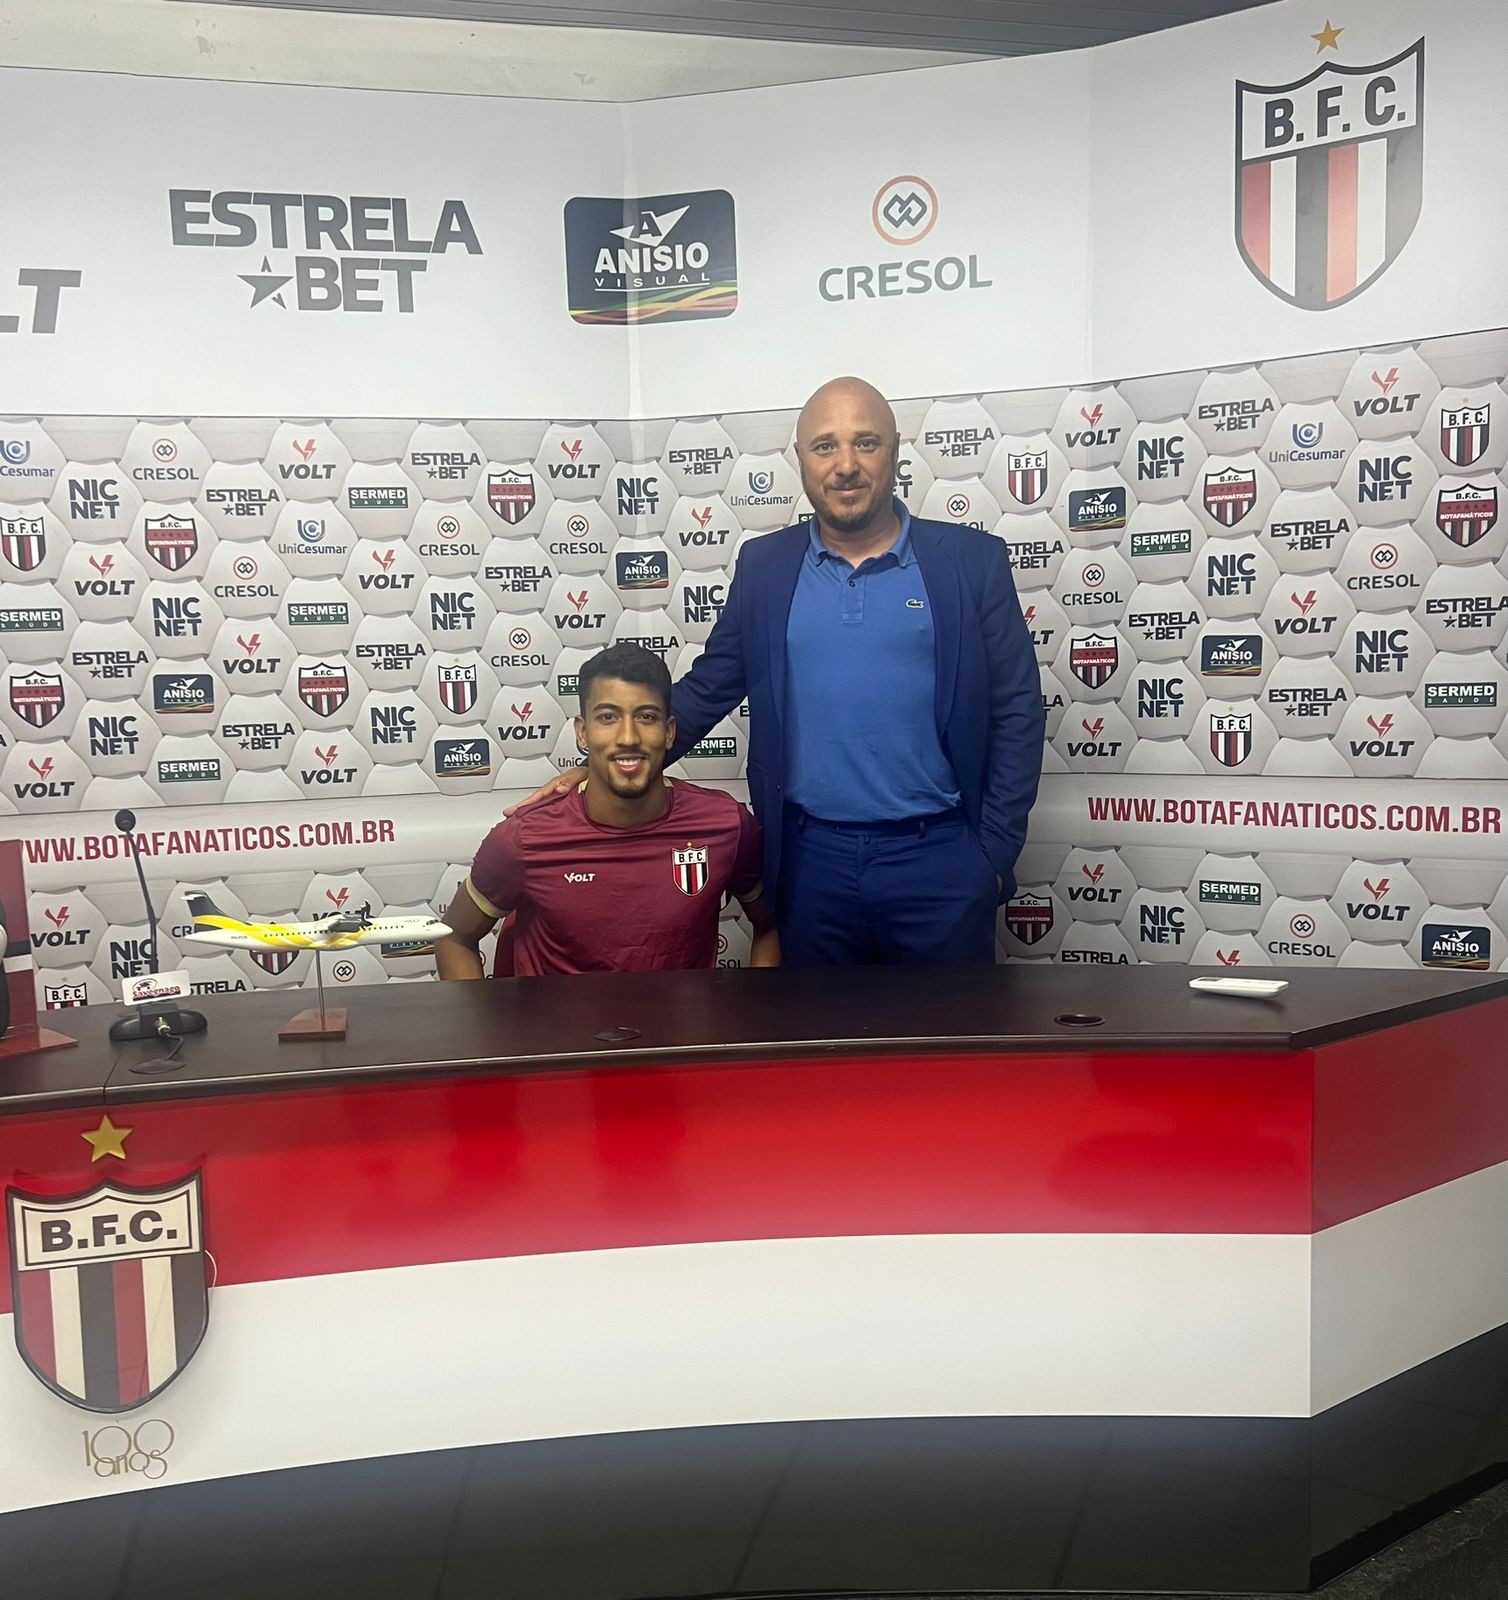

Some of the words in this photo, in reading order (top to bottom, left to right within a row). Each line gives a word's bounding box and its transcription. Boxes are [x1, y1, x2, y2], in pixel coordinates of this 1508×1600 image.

[1265, 76, 1406, 149] B.F.C.
[169, 189, 483, 255] ESTRELA
[595, 242, 709, 273] ANISIO
[295, 255, 427, 313] BET
[595, 272, 710, 287] VISUAL
[818, 254, 993, 302] CRESOL
[1199, 397, 1275, 419] ESTRELA
[1353, 393, 1421, 417] VOLT
[1227, 414, 1260, 432] BET
[925, 427, 995, 445] ESTRELA
[1065, 428, 1121, 448] VOLT
[669, 447, 733, 463] ESTRELA
[952, 442, 981, 457] BET
[1138, 436, 1184, 462] NIC
[1269, 449, 1345, 463] UniCesumar
[411, 452, 480, 466] ESTRELA
[0, 465, 55, 477] Cesumar
[133, 467, 199, 480] CRESOL
[279, 464, 336, 479] VOLT
[439, 466, 469, 479] BET
[548, 464, 600, 479] VOLT
[693, 462, 722, 476] BET
[1138, 458, 1185, 480] NET
[1359, 455, 1412, 482] NIC
[69, 479, 118, 500] NIC
[206, 489, 280, 502] ESTRELA
[350, 489, 406, 499] SERMED
[617, 477, 658, 498] NIC
[1359, 479, 1412, 503] NET
[618, 498, 659, 515] NET
[730, 494, 793, 507] UniCesumar
[71, 501, 120, 519] NET
[234, 503, 267, 516] BET
[1078, 502, 1117, 516] ANISIO
[1271, 518, 1350, 538] ESTRELA
[679, 530, 729, 546] VOLT
[1133, 532, 1189, 547] SERMED
[1300, 536, 1335, 551] BET
[278, 543, 347, 554] UniCesumar
[419, 544, 480, 556] CRESOL
[549, 542, 608, 554] CRESOL
[1006, 541, 1064, 555] TRELA
[1020, 555, 1051, 569] BET
[1208, 553, 1256, 577] NIC
[485, 565, 552, 579] ESTRELA
[624, 565, 661, 576] ANISIO
[74, 580, 135, 596] VOLT
[359, 574, 414, 589] VOLT
[511, 580, 540, 592] BET
[1208, 576, 1256, 597] NET
[1347, 574, 1420, 591] CRESOL
[214, 585, 279, 597] CRESOL
[683, 585, 724, 606] NIC
[1062, 592, 1123, 606] CRESOL
[152, 597, 201, 618] NIC
[290, 604, 347, 616] SERMED
[430, 592, 475, 613] NIC
[1426, 596, 1508, 614] ESTRELA
[0, 611, 61, 622] SERMED
[431, 613, 476, 631] NET
[554, 614, 606, 629] VOLT
[1129, 611, 1200, 627] ESTRELA
[1458, 612, 1496, 628] BET
[154, 619, 202, 637] NET
[1155, 626, 1187, 640] BET
[1274, 616, 1337, 635] VOLT
[1356, 629, 1408, 653] NIC
[72, 651, 149, 665] ESTRELA
[356, 644, 426, 658] ESTRELA
[1211, 651, 1253, 660] ANISIO
[223, 658, 280, 675] VOLT
[383, 658, 413, 671] BET
[490, 654, 550, 667] CRESOL
[1356, 653, 1408, 673] NET
[103, 665, 135, 678] BET
[163, 687, 205, 699] ANISIO
[1138, 678, 1183, 700] NIC
[1268, 687, 1347, 703] ESTRELA
[1428, 685, 1494, 697] SERMED
[371, 705, 416, 726] NIC
[1138, 700, 1184, 718] NET
[1298, 702, 1332, 717] BET
[89, 716, 138, 737] NIC
[222, 722, 295, 737] ESTRELA
[498, 724, 550, 740] VOLT
[372, 726, 417, 744] NET
[91, 737, 139, 756] NET
[251, 737, 283, 750] BET
[693, 740, 735, 749] ERMED
[1067, 742, 1122, 757] VOLT
[1350, 740, 1415, 757] VOLT
[443, 752, 482, 763] ANISIO
[160, 761, 218, 773] SERMED
[300, 768, 357, 784] VOLT
[14, 781, 75, 799] VOLT
[1087, 797, 1501, 834] WWW.BOTAFANATICOS.COM.BR
[25, 819, 395, 863] WW.BOTAFANATICOS.COM.BR
[564, 872, 596, 884] VOLT
[1068, 887, 1122, 903] VOLT
[1202, 882, 1259, 896] SERMED
[1140, 904, 1185, 927] NIC
[1346, 903, 1410, 921] VOLT
[31, 929, 90, 948] VOLT
[1140, 926, 1185, 945] NET
[1268, 941, 1336, 958] CRESOL
[1432, 940, 1479, 954] ANISIO
[1062, 950, 1129, 965] ESTRELA
[190, 980, 247, 995] TRELA
[40, 1210, 178, 1253] B.F.C.
